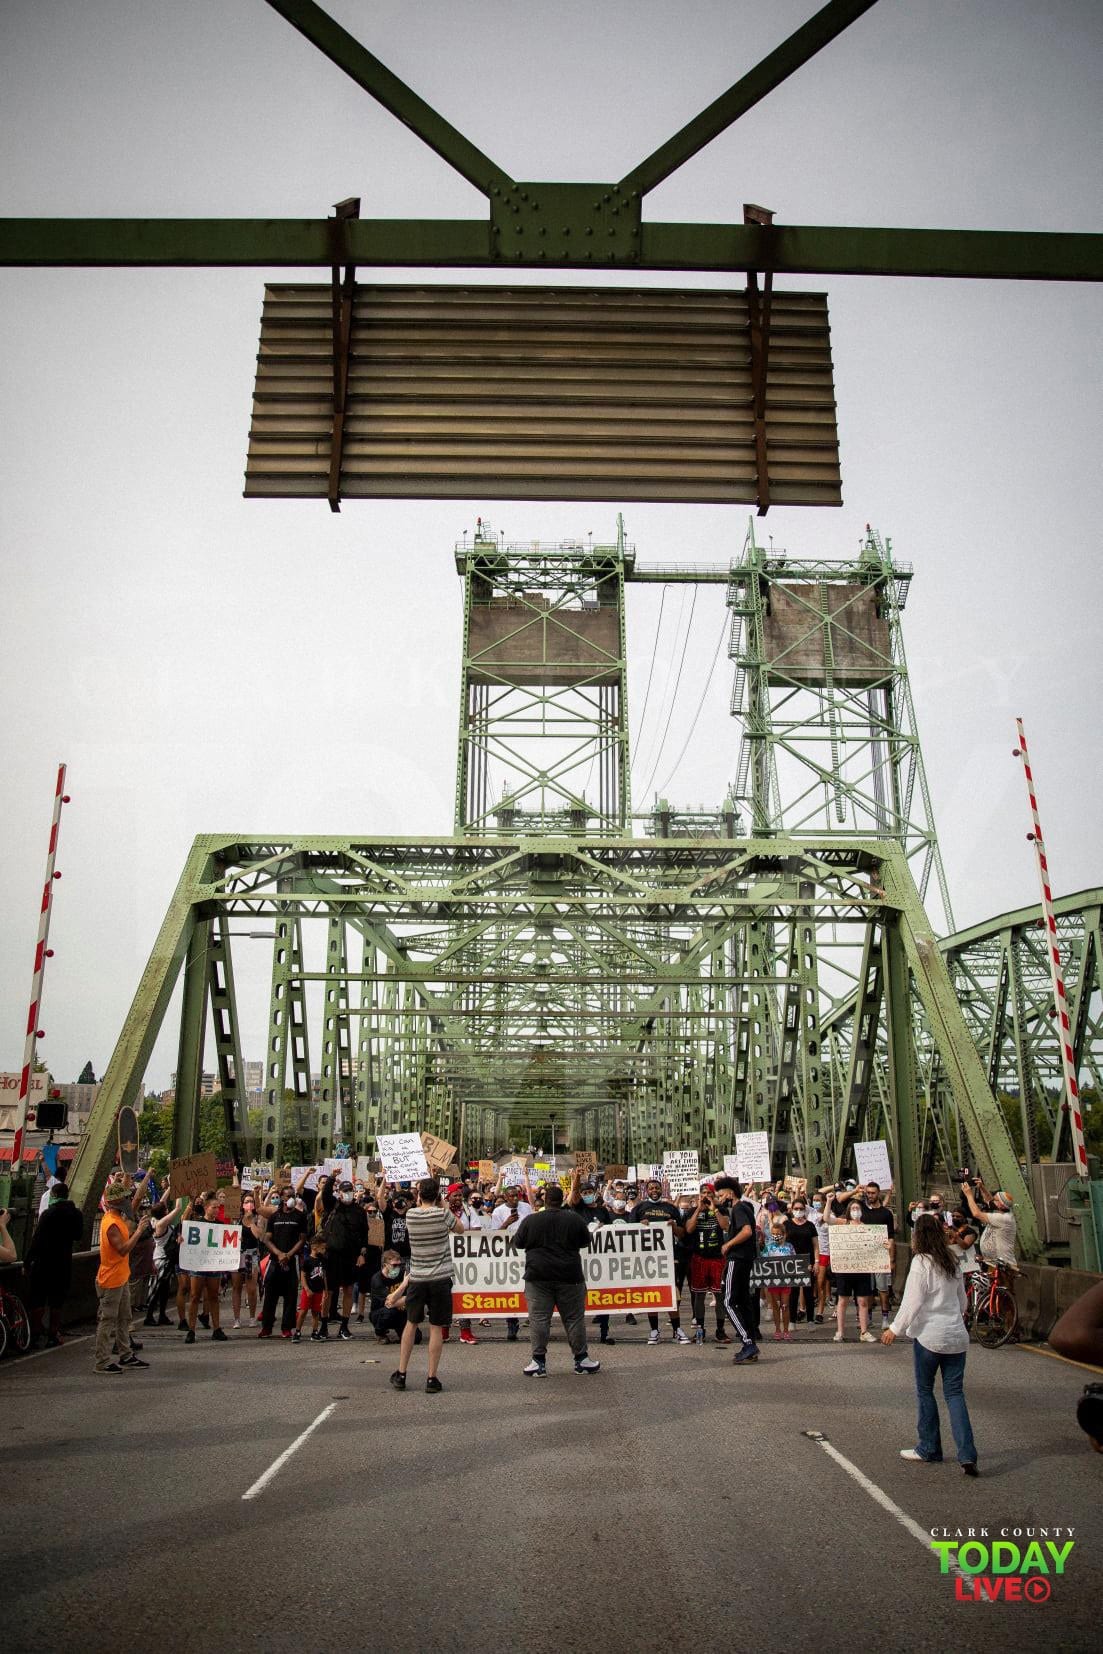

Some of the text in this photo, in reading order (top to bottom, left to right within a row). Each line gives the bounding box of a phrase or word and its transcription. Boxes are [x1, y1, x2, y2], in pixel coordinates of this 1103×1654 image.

[392, 1155, 410, 1164] BUT
[423, 1136, 454, 1168] BLM
[680, 1151, 693, 1159] YOU
[187, 1226, 239, 1248] BLM
[453, 1228, 666, 1258] BLACK MATTER
[454, 1262, 478, 1286] NO
[484, 1260, 527, 1286] JUS
[609, 1255, 669, 1281] PEACE
[462, 1288, 661, 1309] Stand Racism
